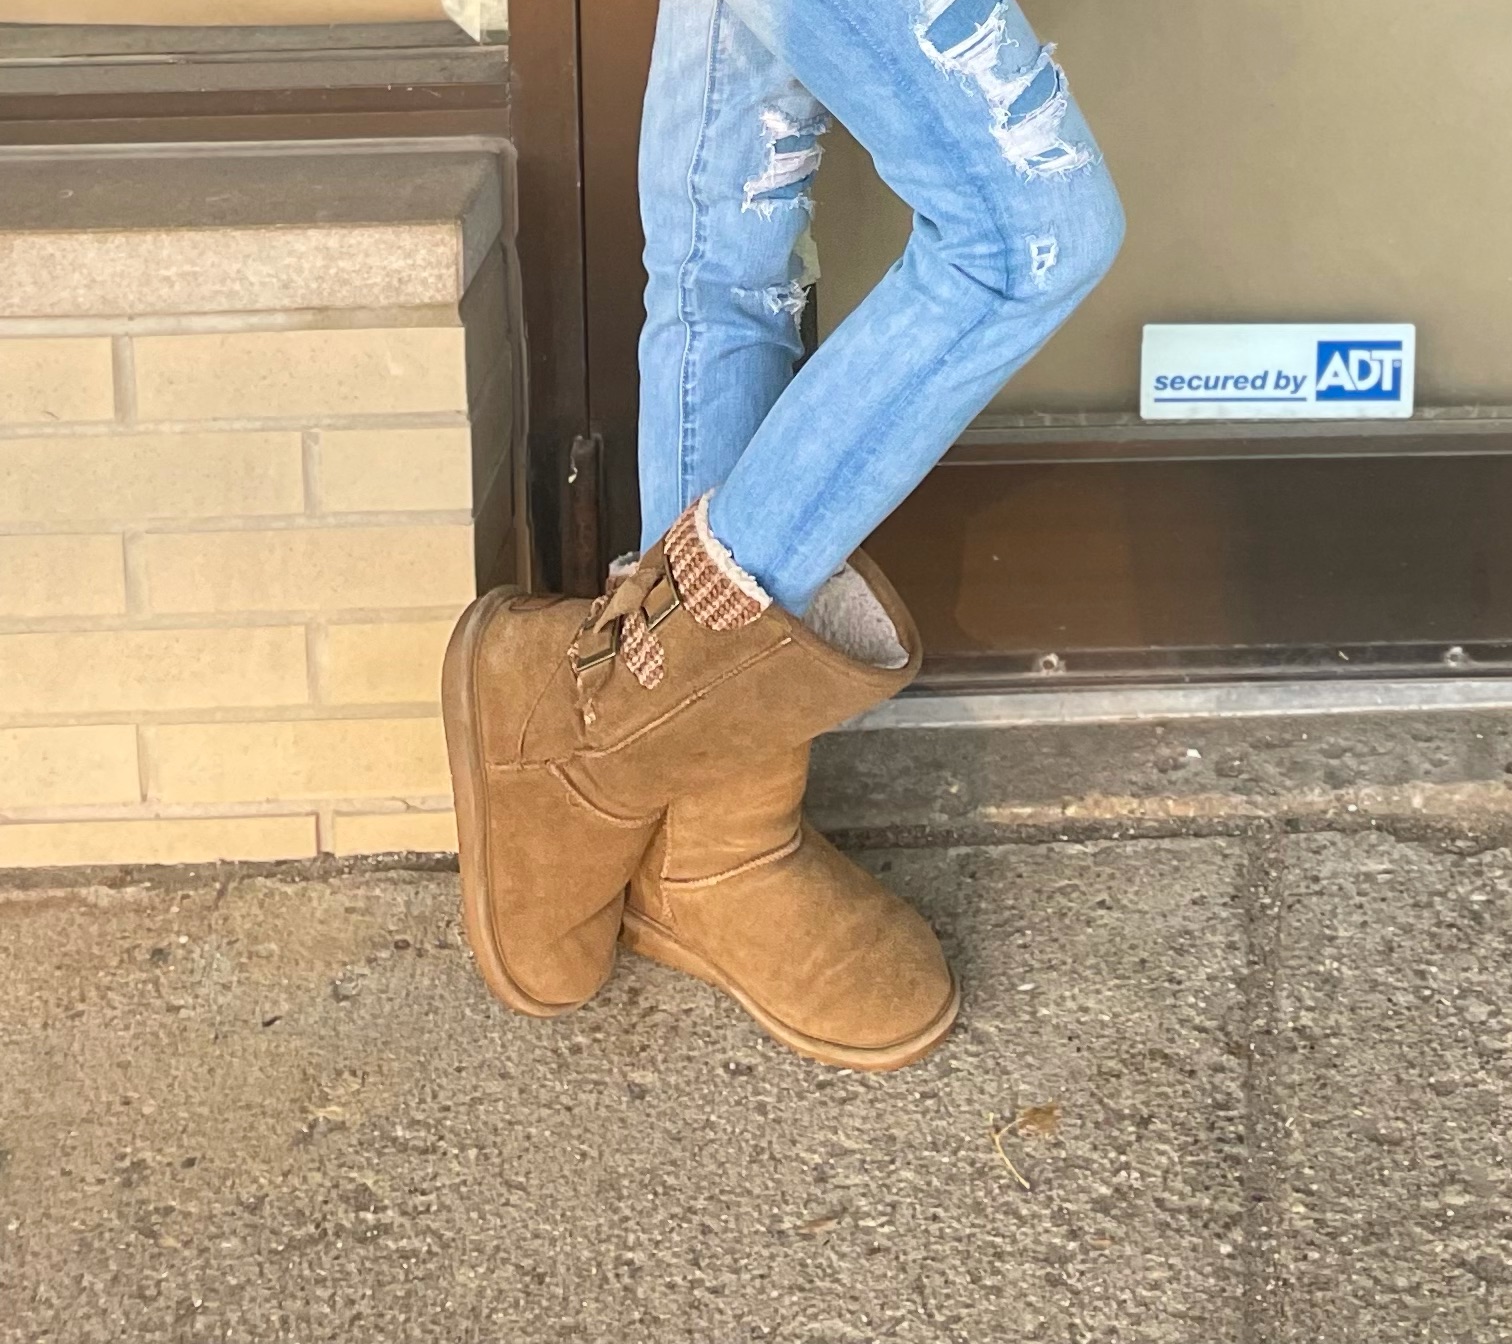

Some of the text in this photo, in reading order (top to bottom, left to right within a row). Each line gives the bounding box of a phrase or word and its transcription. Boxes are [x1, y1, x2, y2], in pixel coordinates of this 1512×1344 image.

[1154, 350, 1402, 394] secured by ADT
